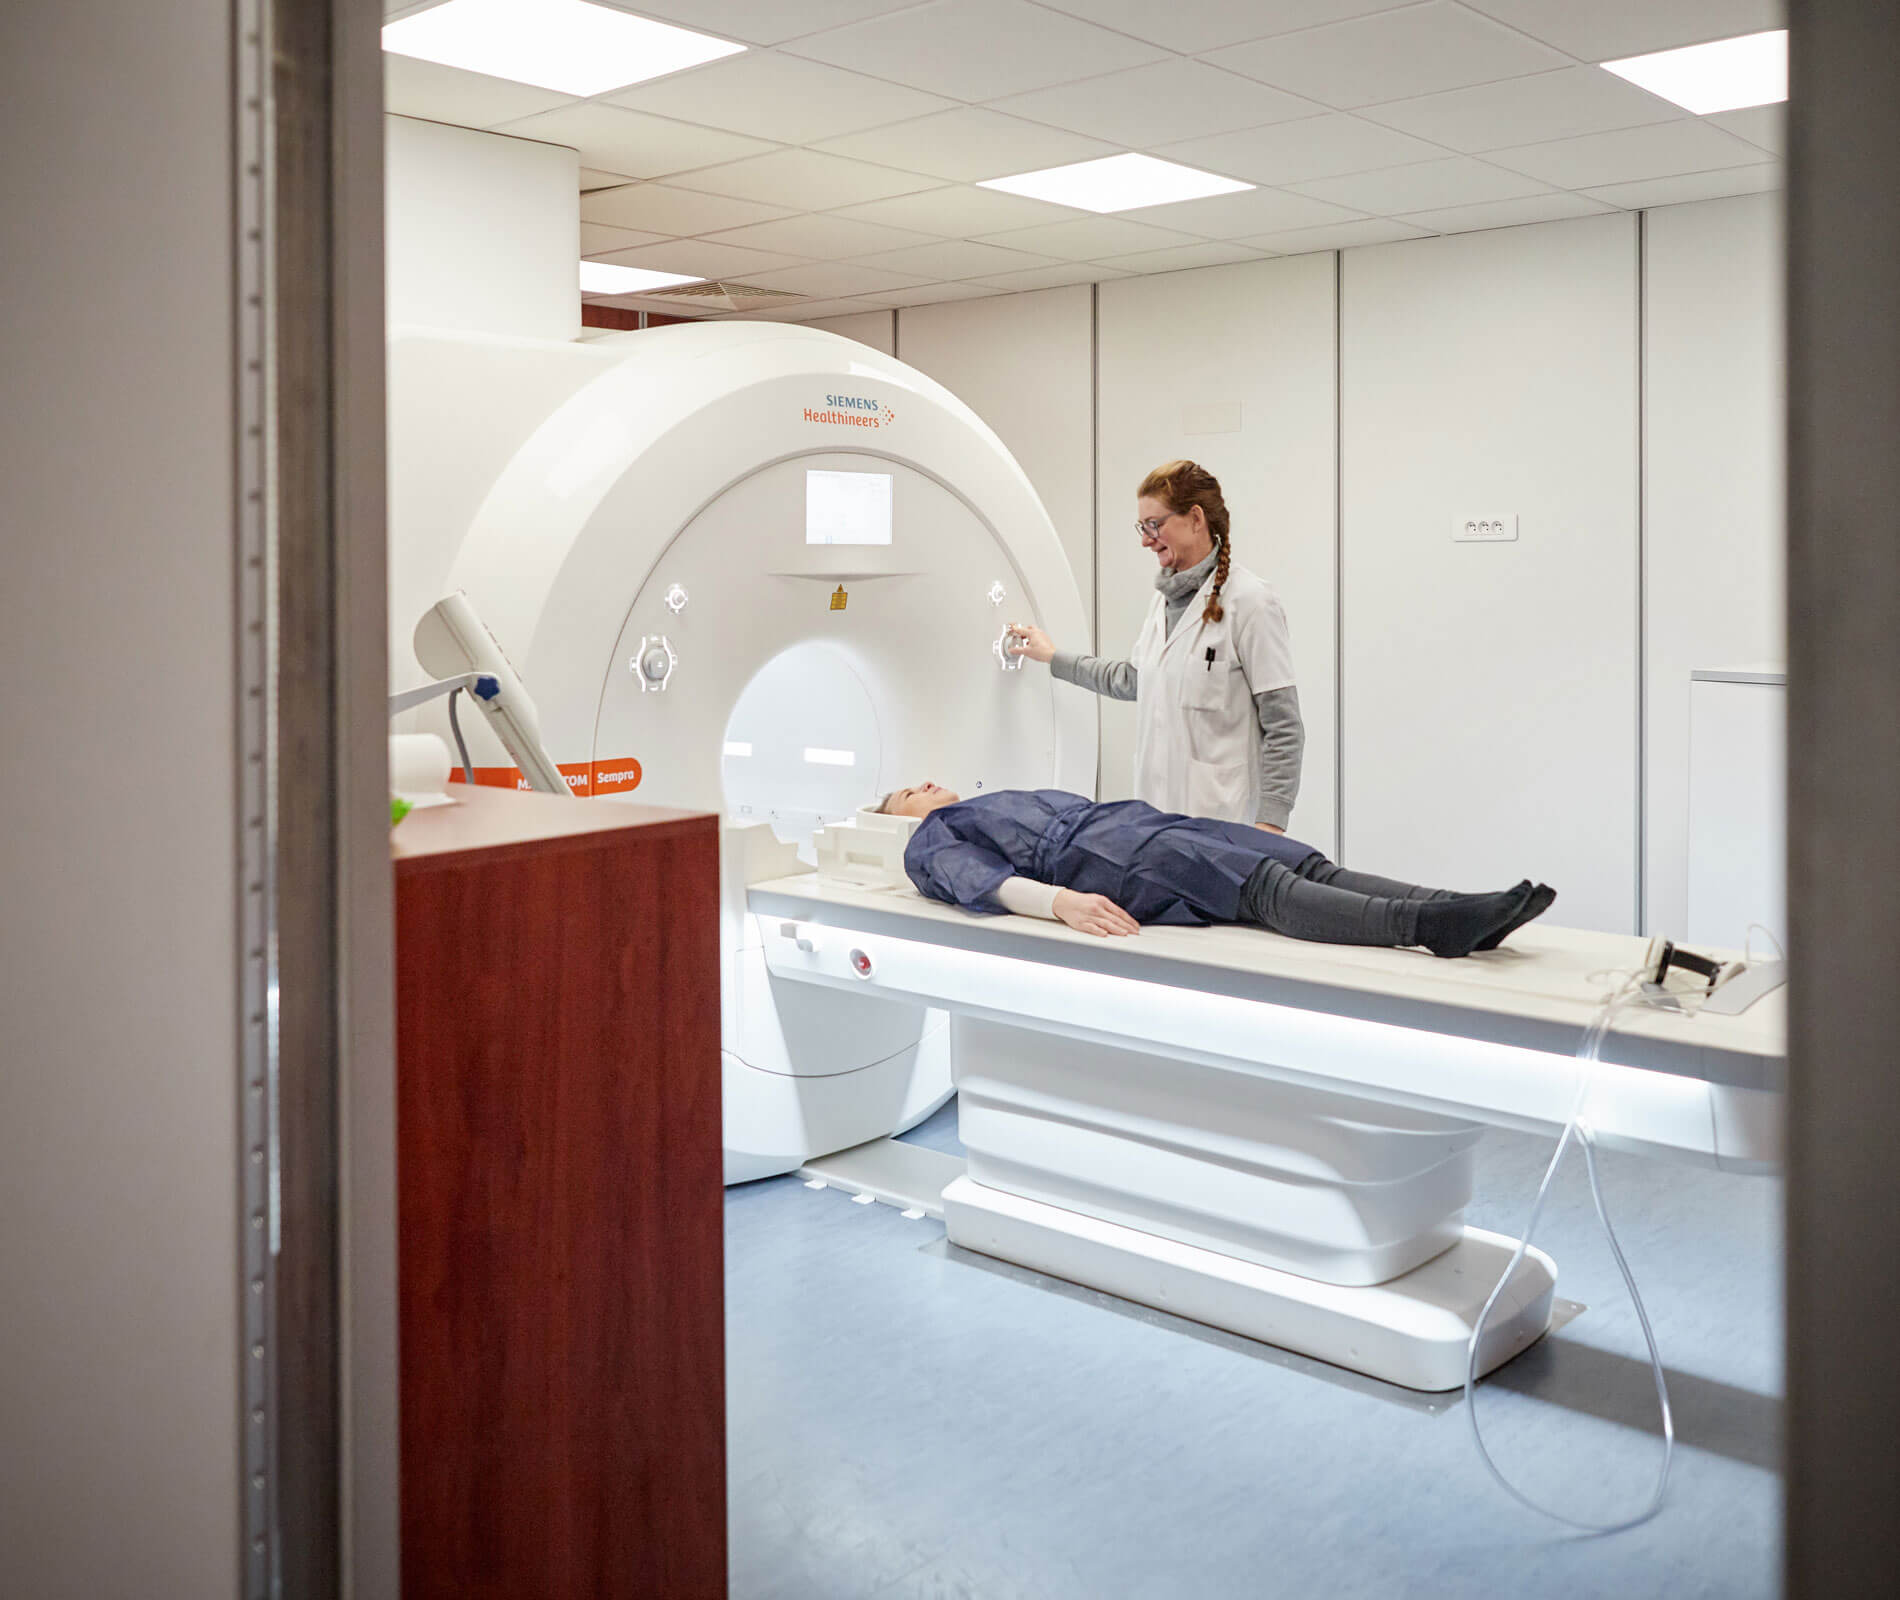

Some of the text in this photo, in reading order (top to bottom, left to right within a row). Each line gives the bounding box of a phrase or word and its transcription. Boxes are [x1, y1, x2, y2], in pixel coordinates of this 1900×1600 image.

[826, 394, 879, 411] SIEMENS
[803, 407, 880, 428] Healthineers
[597, 770, 634, 784] Sempra
